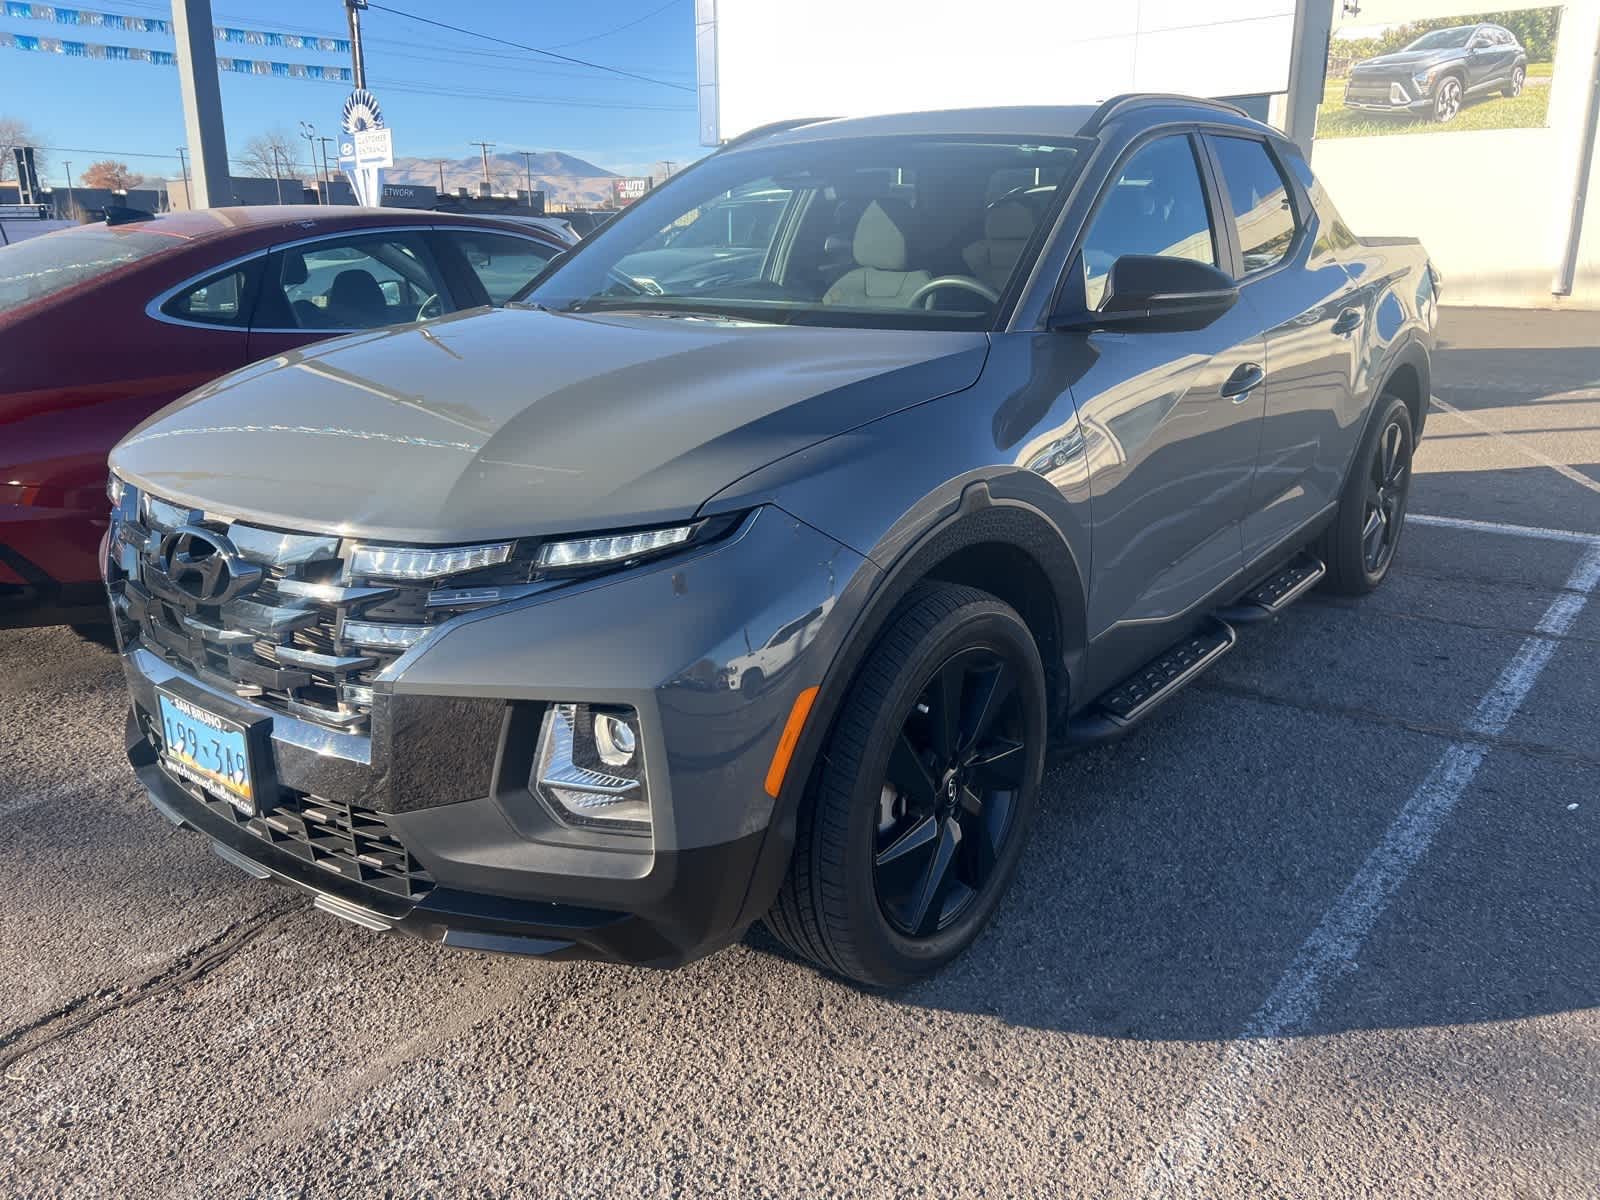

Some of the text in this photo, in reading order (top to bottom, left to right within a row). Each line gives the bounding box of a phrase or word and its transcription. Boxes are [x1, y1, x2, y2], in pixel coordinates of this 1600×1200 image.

[384, 188, 414, 197] ETWORK
[175, 698, 222, 729] SAN BRUNO
